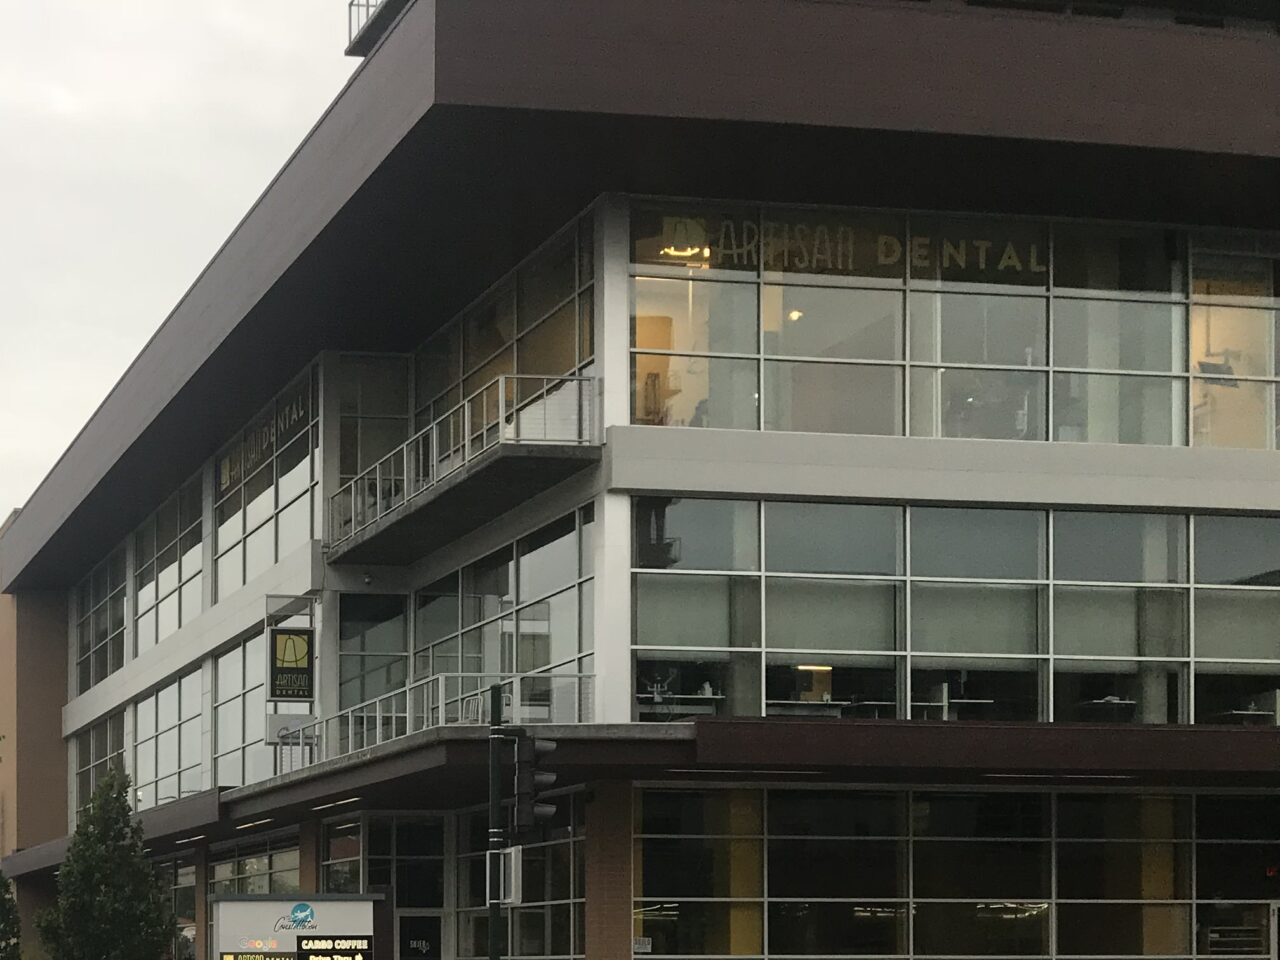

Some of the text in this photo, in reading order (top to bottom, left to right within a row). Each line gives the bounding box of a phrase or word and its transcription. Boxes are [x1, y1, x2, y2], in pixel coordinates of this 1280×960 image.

[875, 234, 1048, 273] DENTAL
[275, 673, 308, 687] ARTISAN
[301, 939, 369, 950] CARGO COFFEE
